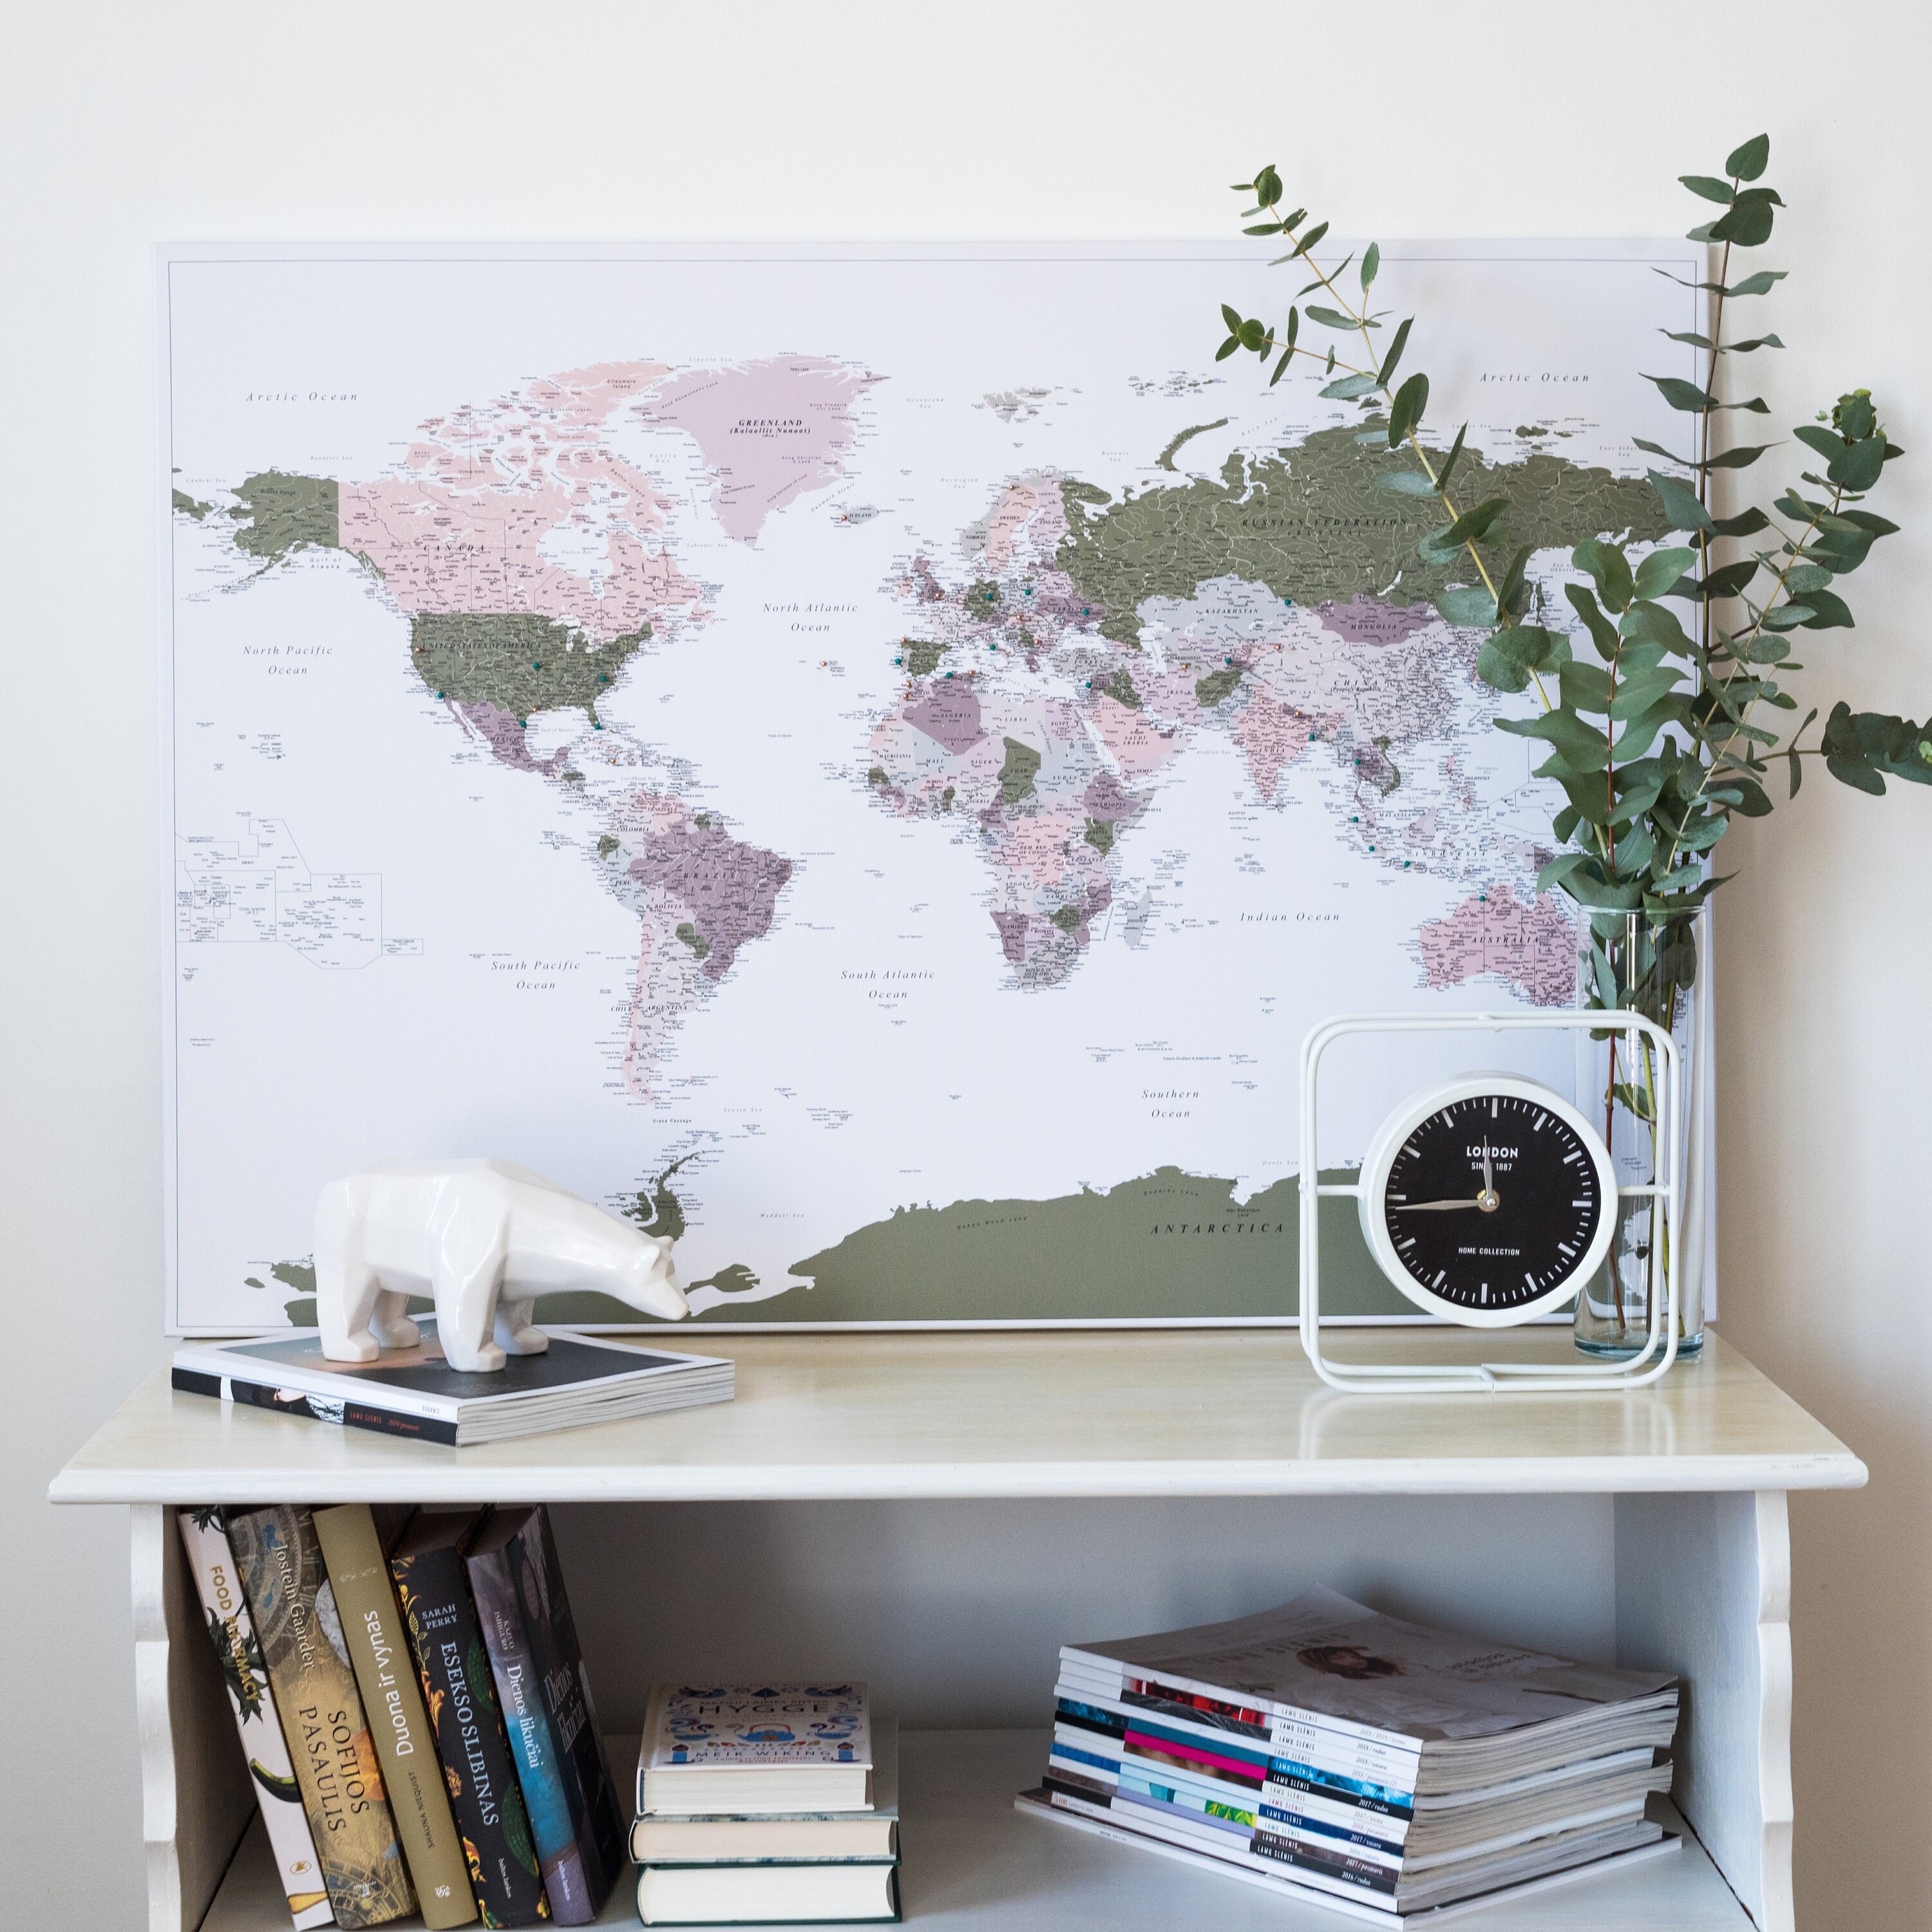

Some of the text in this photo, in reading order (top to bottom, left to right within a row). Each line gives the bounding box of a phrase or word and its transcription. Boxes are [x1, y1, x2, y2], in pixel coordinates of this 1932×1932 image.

[1480, 372, 1590, 382] Arctic Ocean
[246, 391, 358, 402] Arctic Ocean
[1242, 518, 1408, 527] RUSSIAN FEDERATION
[762, 603, 858, 612] North Atlantic
[791, 622, 830, 632] Ocean
[243, 645, 333, 657] North Pacific
[268, 665, 308, 674] Ocean
[1240, 912, 1340, 922] Indian Ocean
[491, 960, 580, 972] South Pacific
[841, 969, 936, 980] South Atlantic
[516, 980, 556, 989] Ocean
[869, 989, 908, 999] Ocean
[1142, 1089, 1199, 1099] Southern
[1151, 1108, 1190, 1118] Ocean
[1466, 1146, 1519, 1159] LONDON
[1496, 1162, 1512, 1171] 1887
[1150, 1223, 1284, 1234] ANTARCTICA
[1458, 1247, 1520, 1256] HOME COLLECTION
[270, 1544, 315, 1669] Jostein Gaarder
[421, 1603, 457, 1620] SARAH
[426, 1613, 459, 1631] PERRY
[210, 1565, 260, 1701] FOOD PHARMACY
[494, 1611, 508, 1652] ISHIGURO
[503, 1620, 516, 1650] KAZUO
[364, 1609, 414, 1757] Duona ir vynas
[699, 1704, 829, 1714] HYGGE
[507, 1663, 527, 1716] Dienos
[519, 1716, 544, 1770] likučiai
[440, 1640, 500, 1826] ESEKSO SLIBINAS
[327, 1710, 370, 1815] SOFIJOS
[1356, 1756, 1368, 1765] 2018
[298, 1705, 348, 1832] PASAULIS
[1359, 1799, 1371, 1808] 2017
[408, 1770, 435, 1850] SHAUNA NIEQUIST
[1350, 1833, 1363, 1842] 2017
[1346, 1857, 1358, 1866] 2017
[1341, 1871, 1354, 1880] 2016
